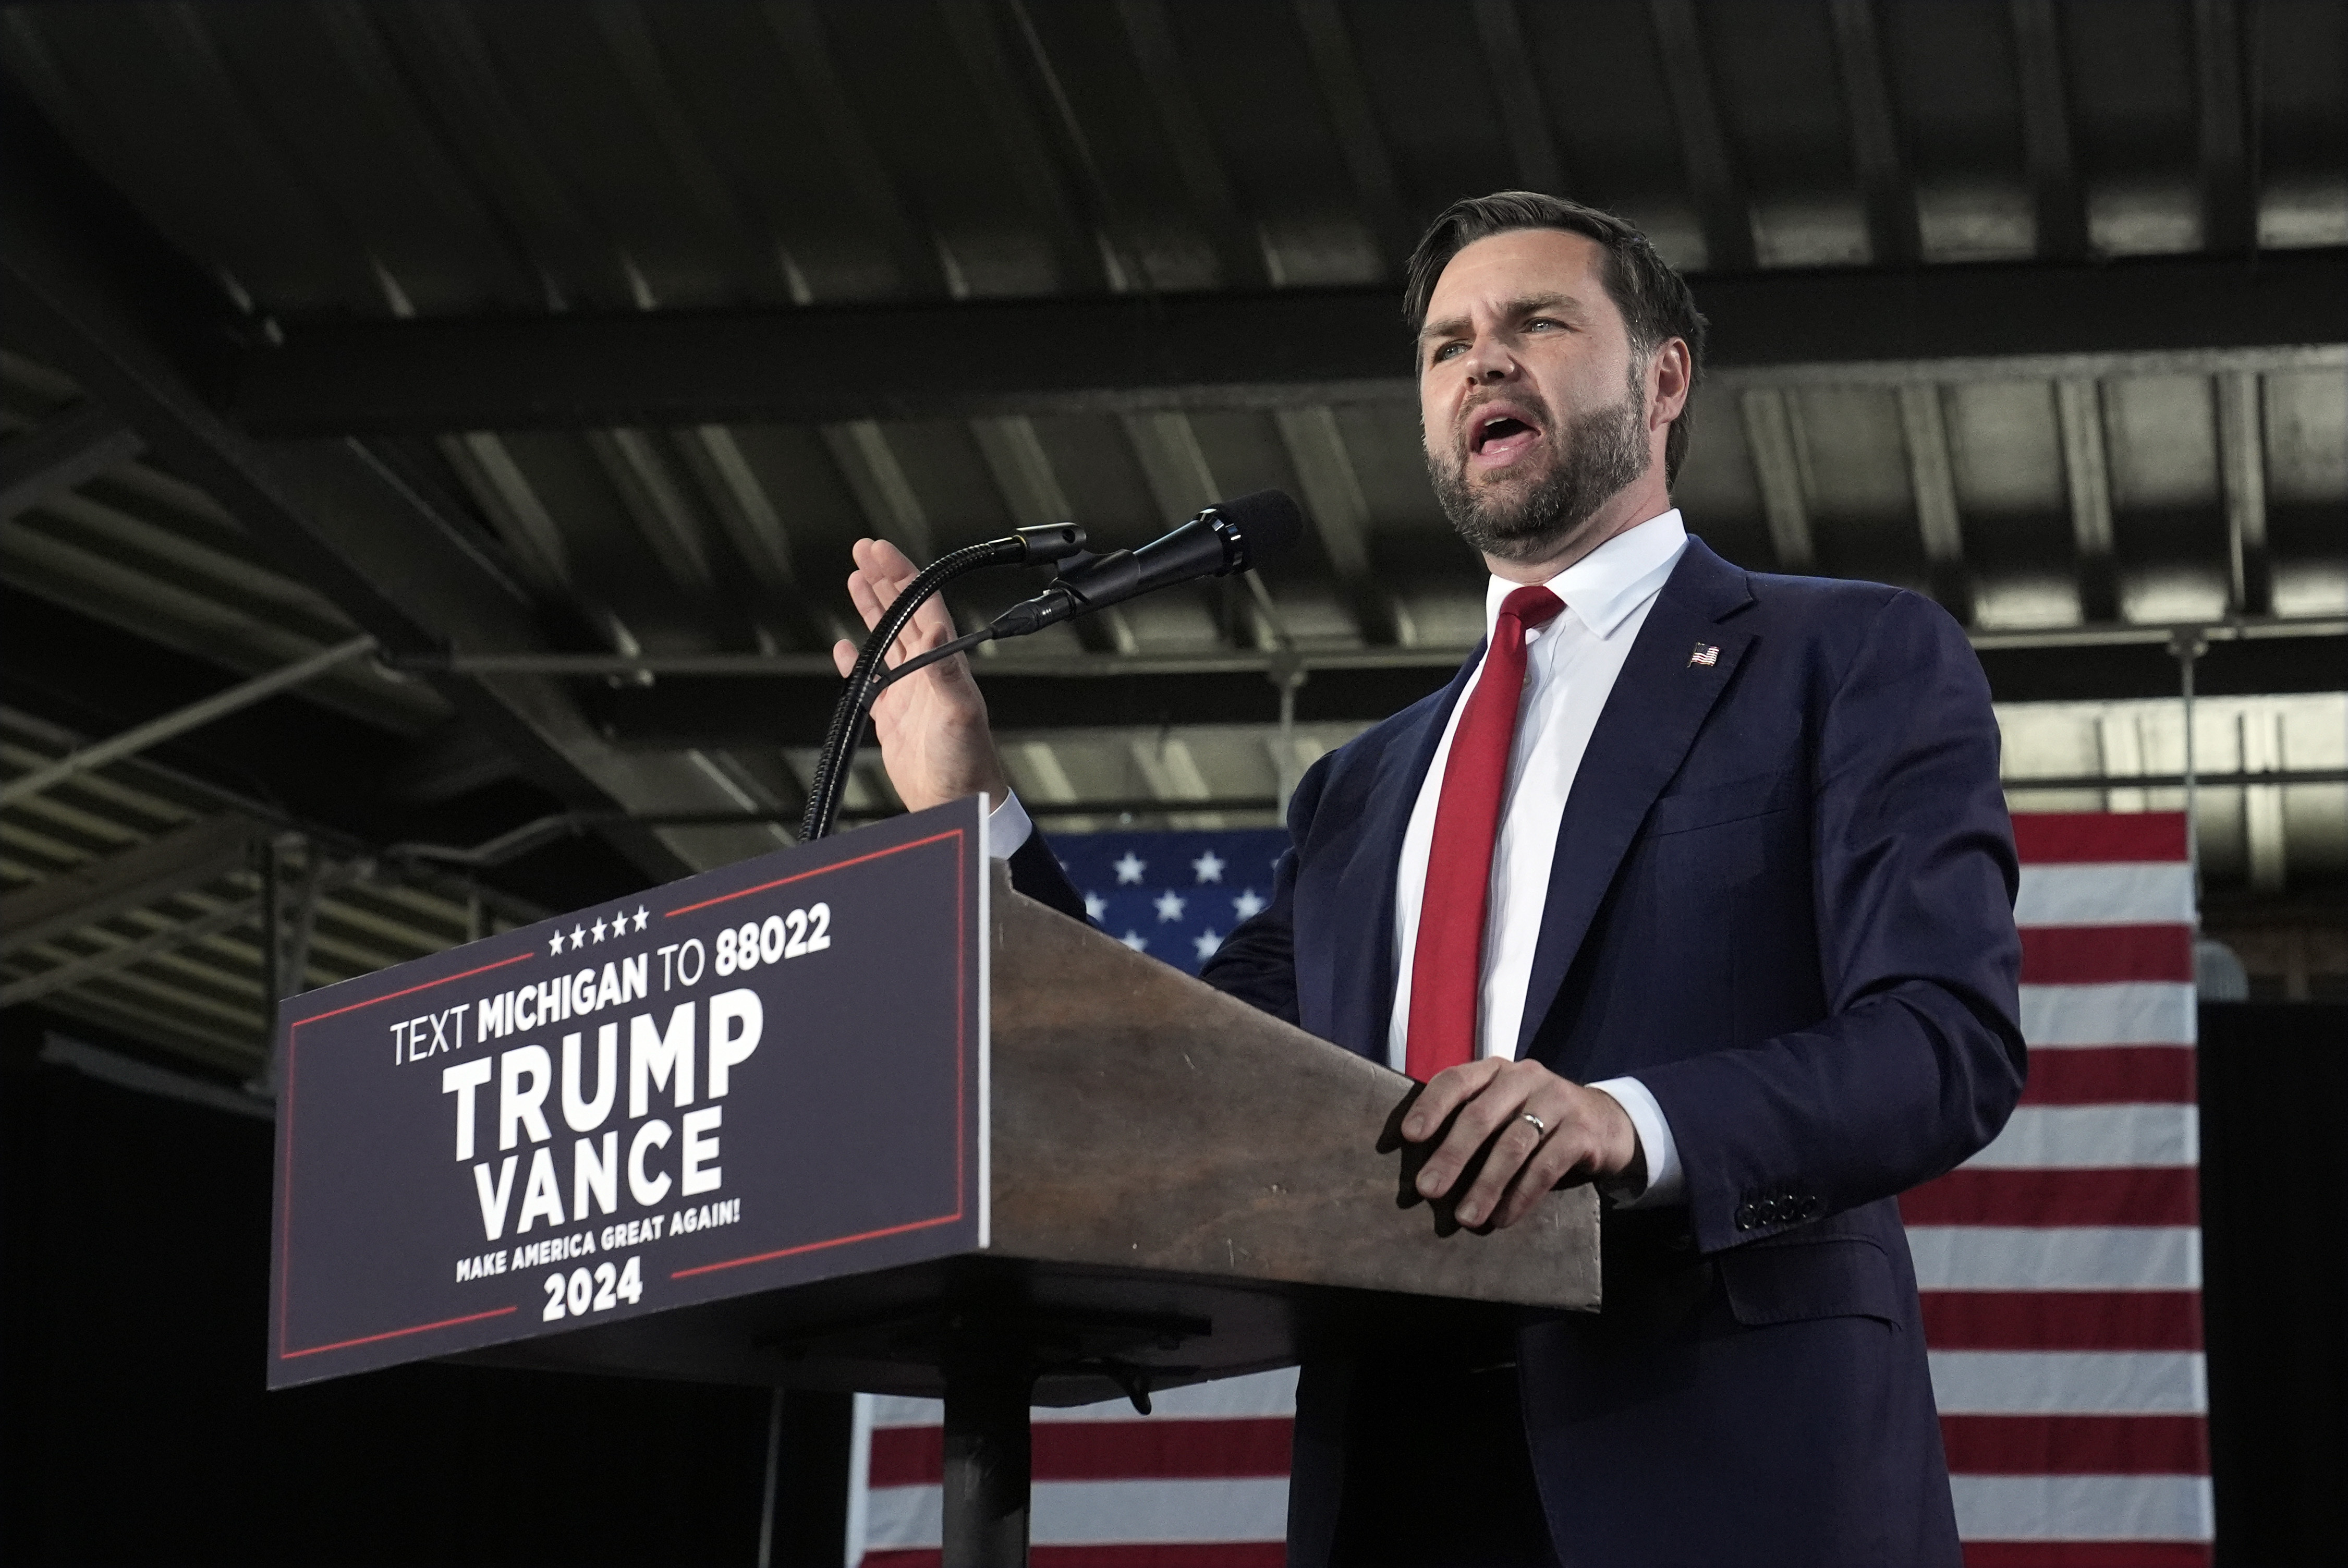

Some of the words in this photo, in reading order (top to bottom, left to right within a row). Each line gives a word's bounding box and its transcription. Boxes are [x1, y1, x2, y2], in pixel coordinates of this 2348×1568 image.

[390, 1003, 470, 1066] TEXT
[477, 953, 648, 1043] MICHIGAN
[656, 938, 705, 992] TO
[715, 902, 831, 977] 88022
[442, 988, 763, 1162] TRUMP
[456, 1250, 507, 1283] MAKE
[511, 1231, 596, 1271] AMERICA
[601, 1214, 665, 1251] GREAT
[669, 1198, 740, 1236] AGAIN!
[473, 1105, 722, 1241] VANCE
[543, 1256, 643, 1322] 2024
